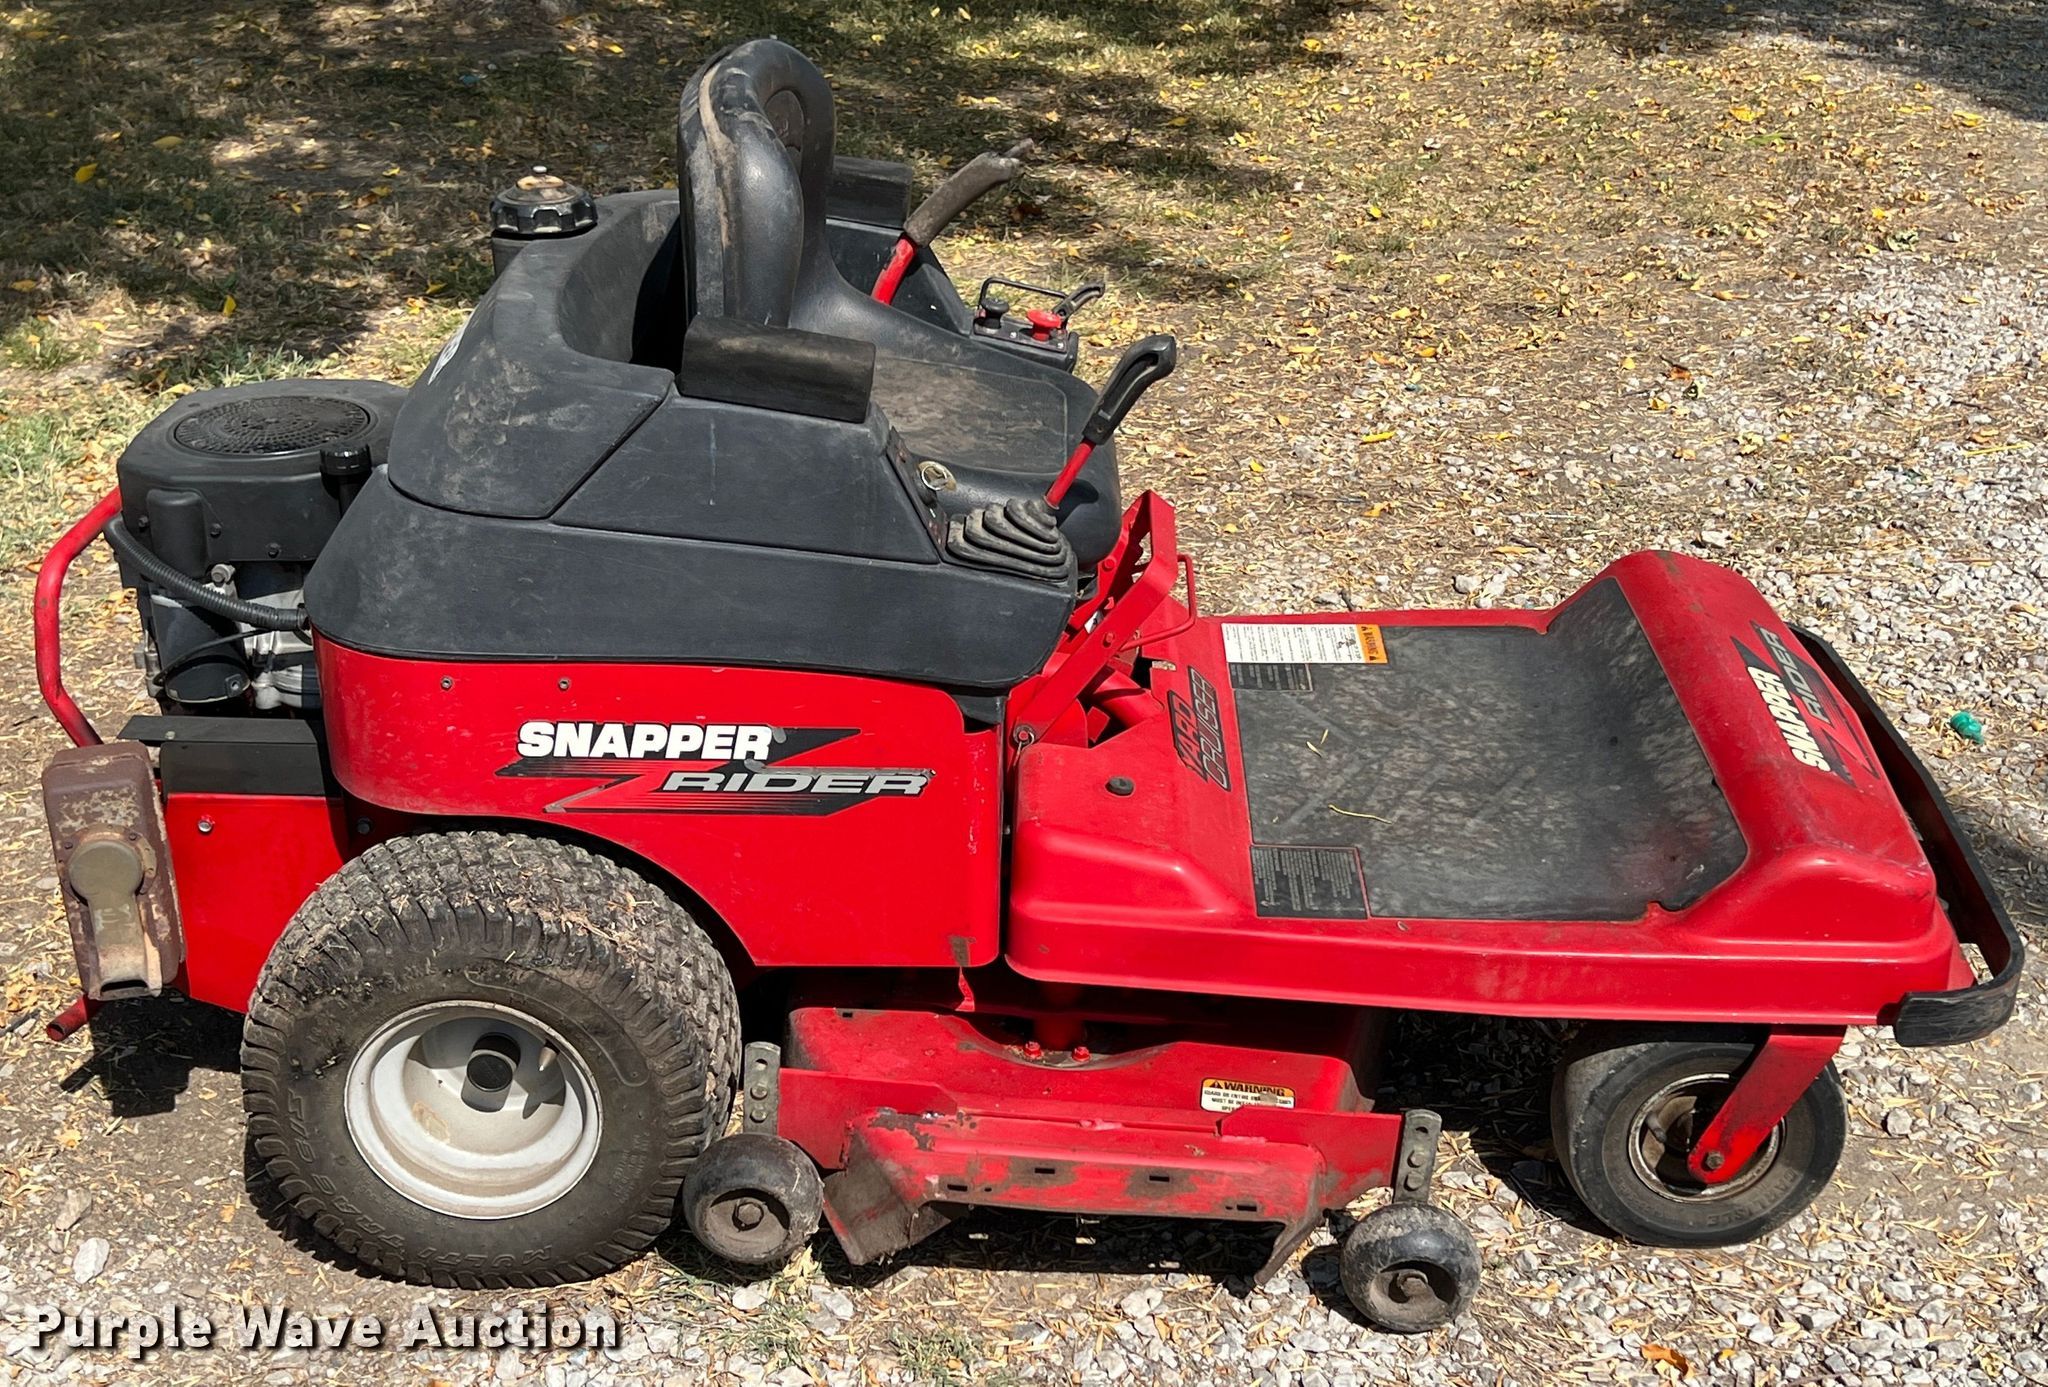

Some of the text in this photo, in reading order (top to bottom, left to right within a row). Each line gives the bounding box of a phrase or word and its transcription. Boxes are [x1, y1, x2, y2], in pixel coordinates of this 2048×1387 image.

[1759, 627, 1831, 724] RIDER
[517, 721, 773, 761] SNAPPER
[1189, 667, 1228, 790] CRUISER
[1747, 666, 1831, 772] SNAPPER
[662, 771, 931, 795] RIDER
[1224, 1082, 1285, 1097] WARNING
